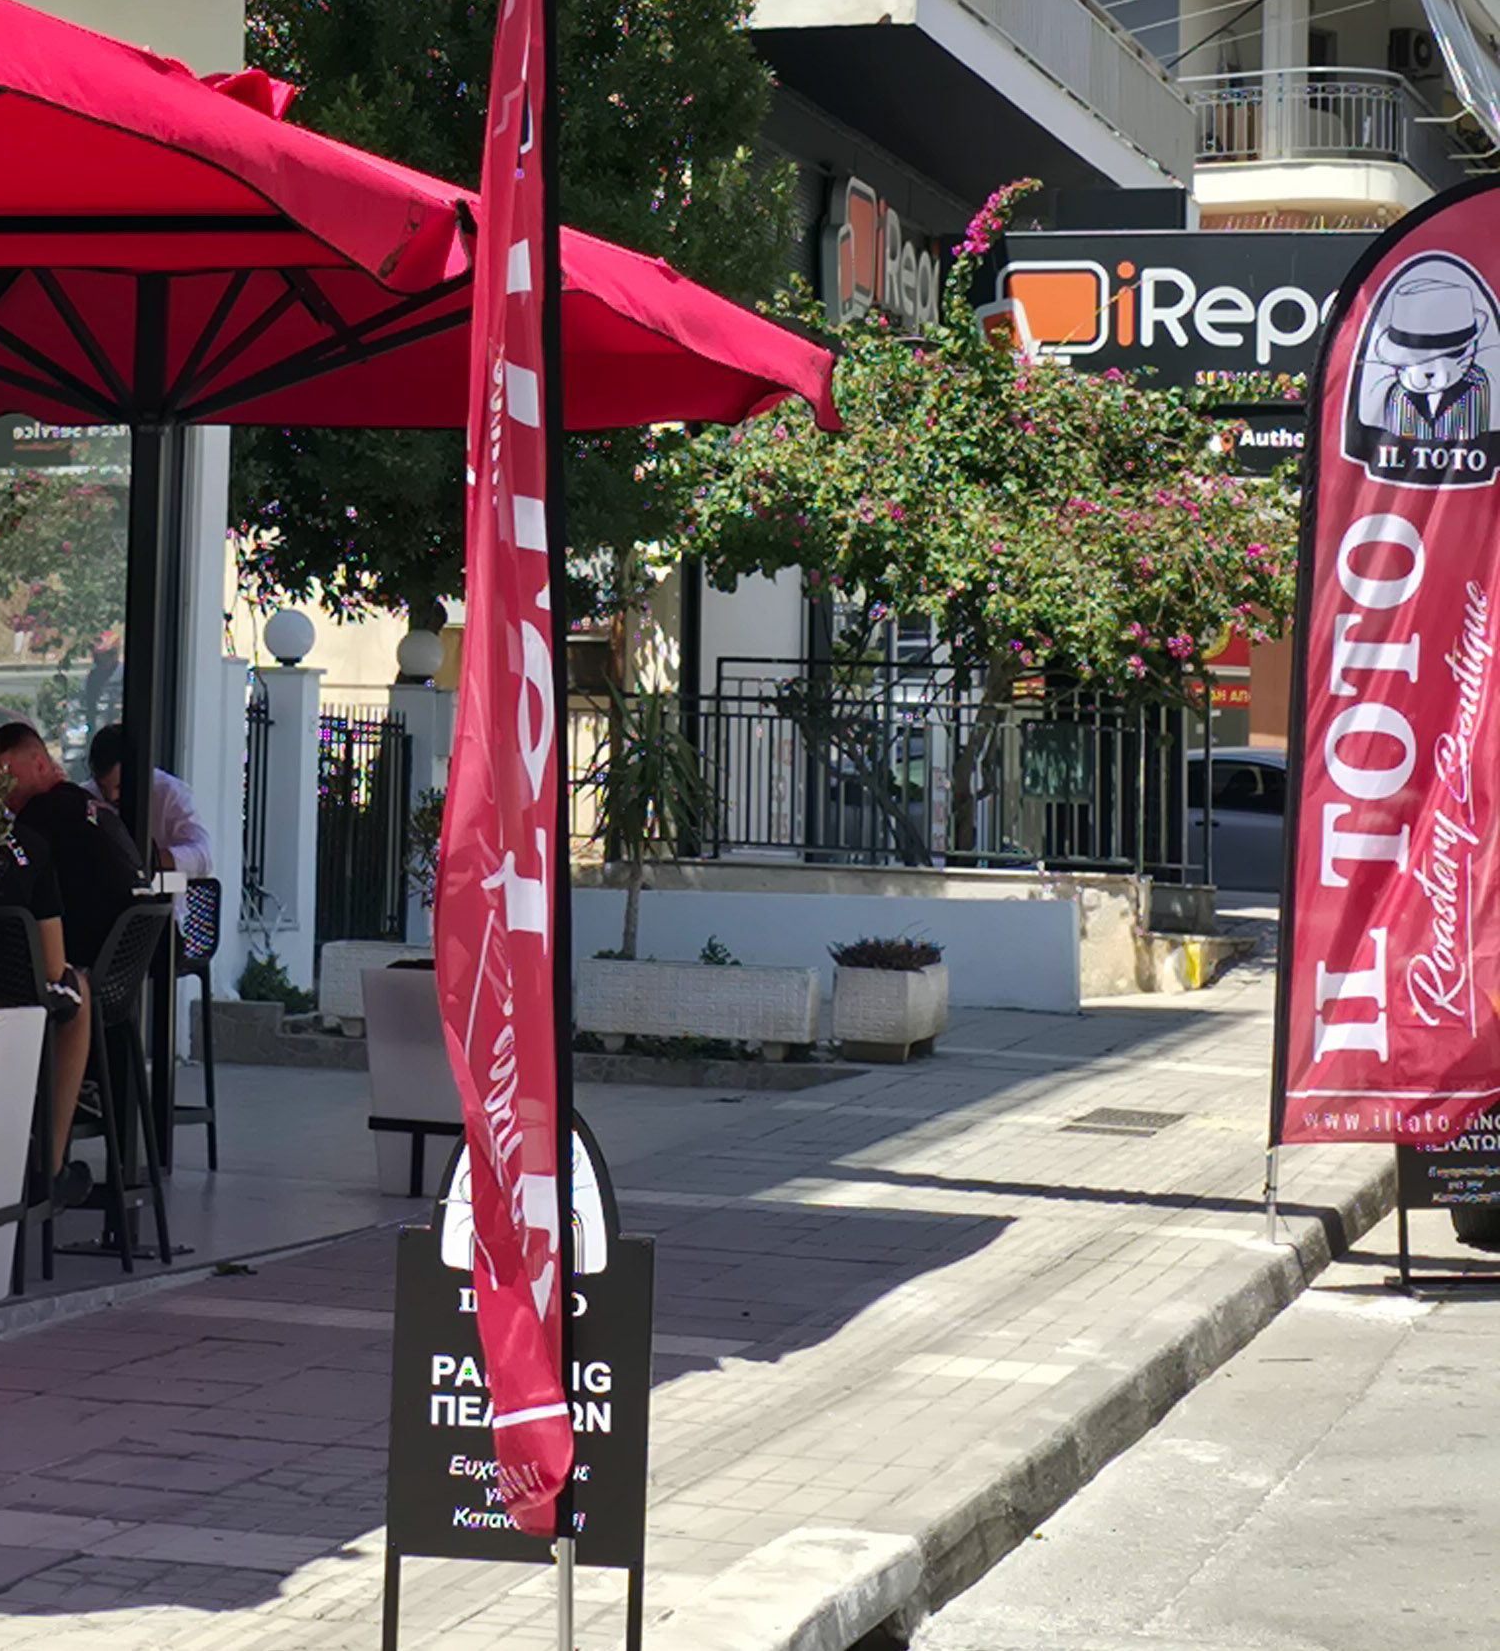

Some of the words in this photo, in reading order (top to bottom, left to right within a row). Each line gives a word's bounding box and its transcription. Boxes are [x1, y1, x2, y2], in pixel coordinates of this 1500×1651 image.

[875, 198, 941, 335] iRep
[1116, 260, 1340, 365] iRep
[1378, 445, 1406, 468] IL
[1412, 446, 1487, 472] TOTO
[1320, 513, 1426, 888] TOTO
[1434, 580, 1493, 804] Boutique
[1406, 809, 1480, 1027] Roastery
[1313, 926, 1389, 1064] IL
